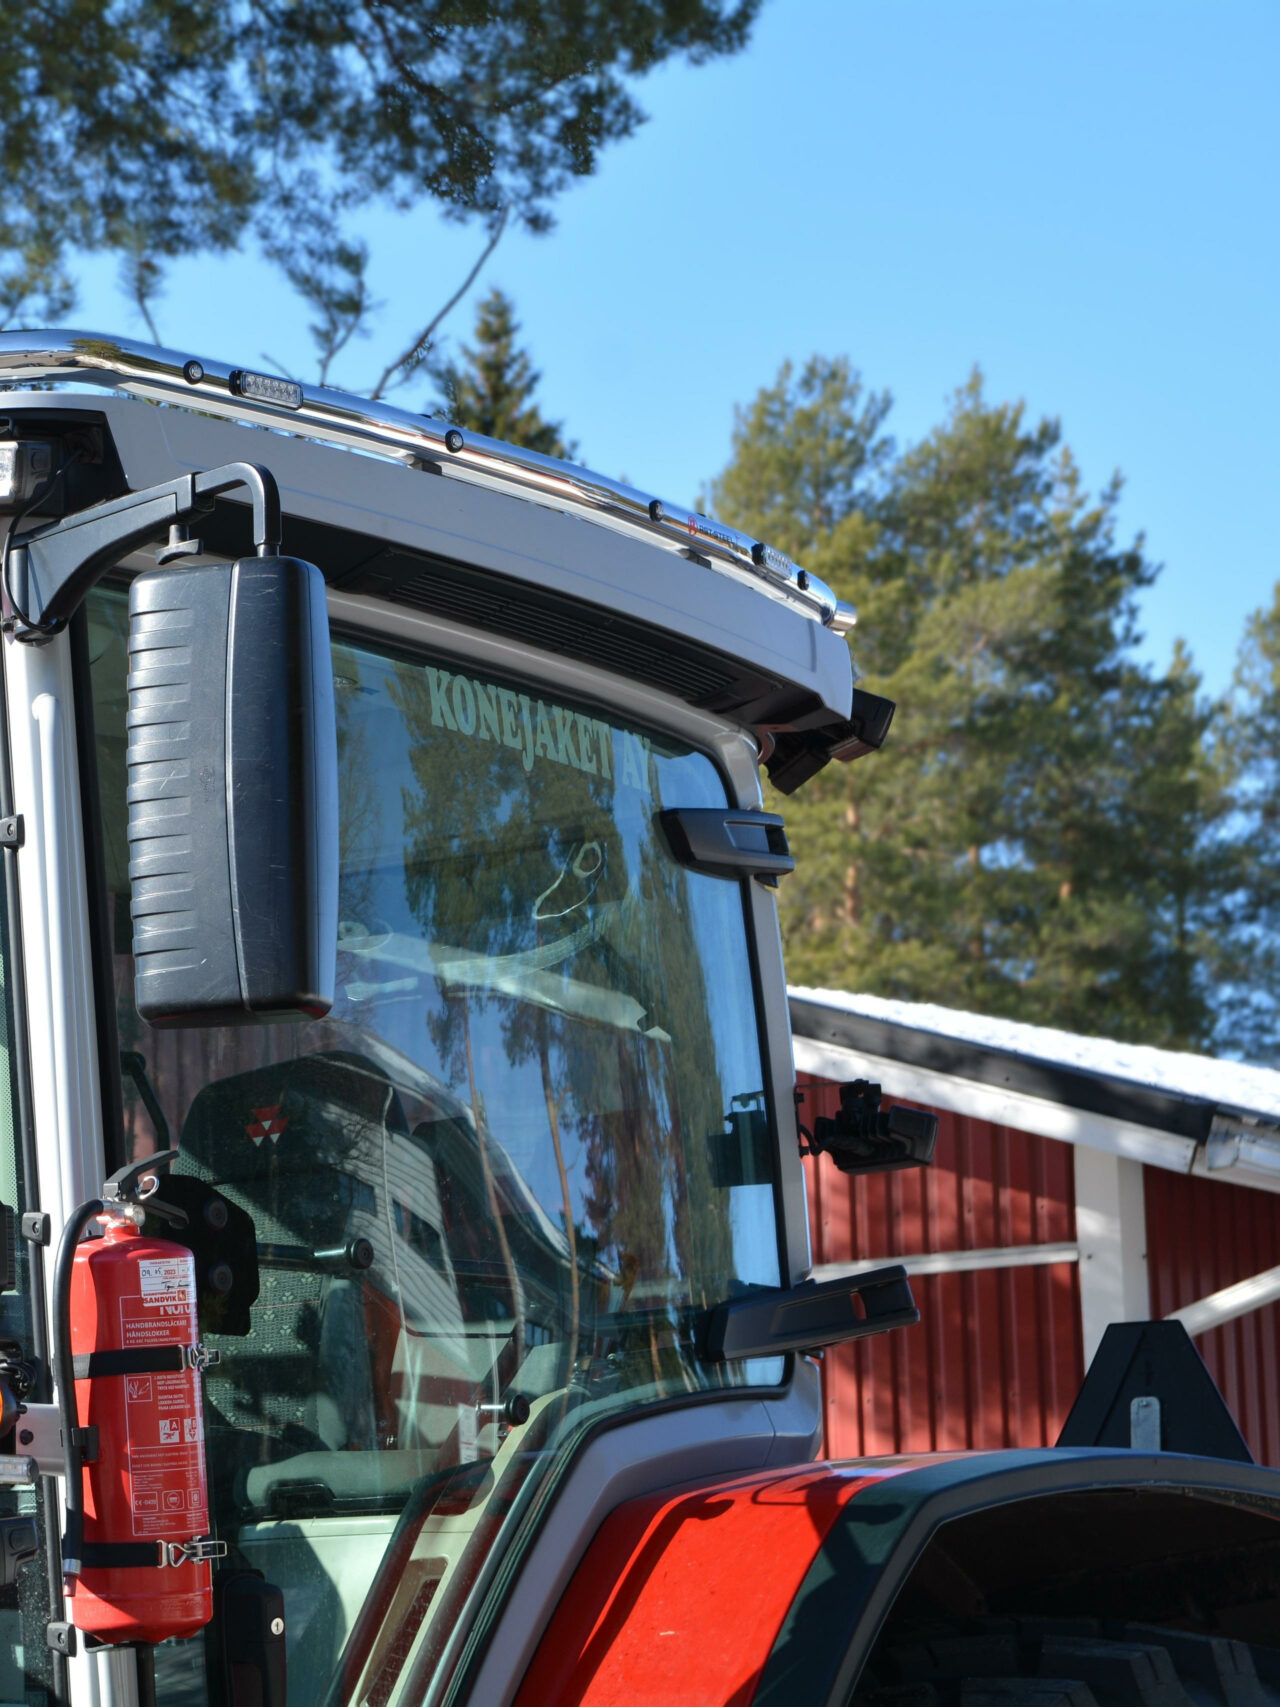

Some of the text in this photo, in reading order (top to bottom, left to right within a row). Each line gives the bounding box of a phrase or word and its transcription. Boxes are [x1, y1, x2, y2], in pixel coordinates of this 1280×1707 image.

[425, 667, 651, 796] KONEJAKET AY
[143, 1296, 177, 1304] SANDVIK
[171, 1421, 178, 1429] A
